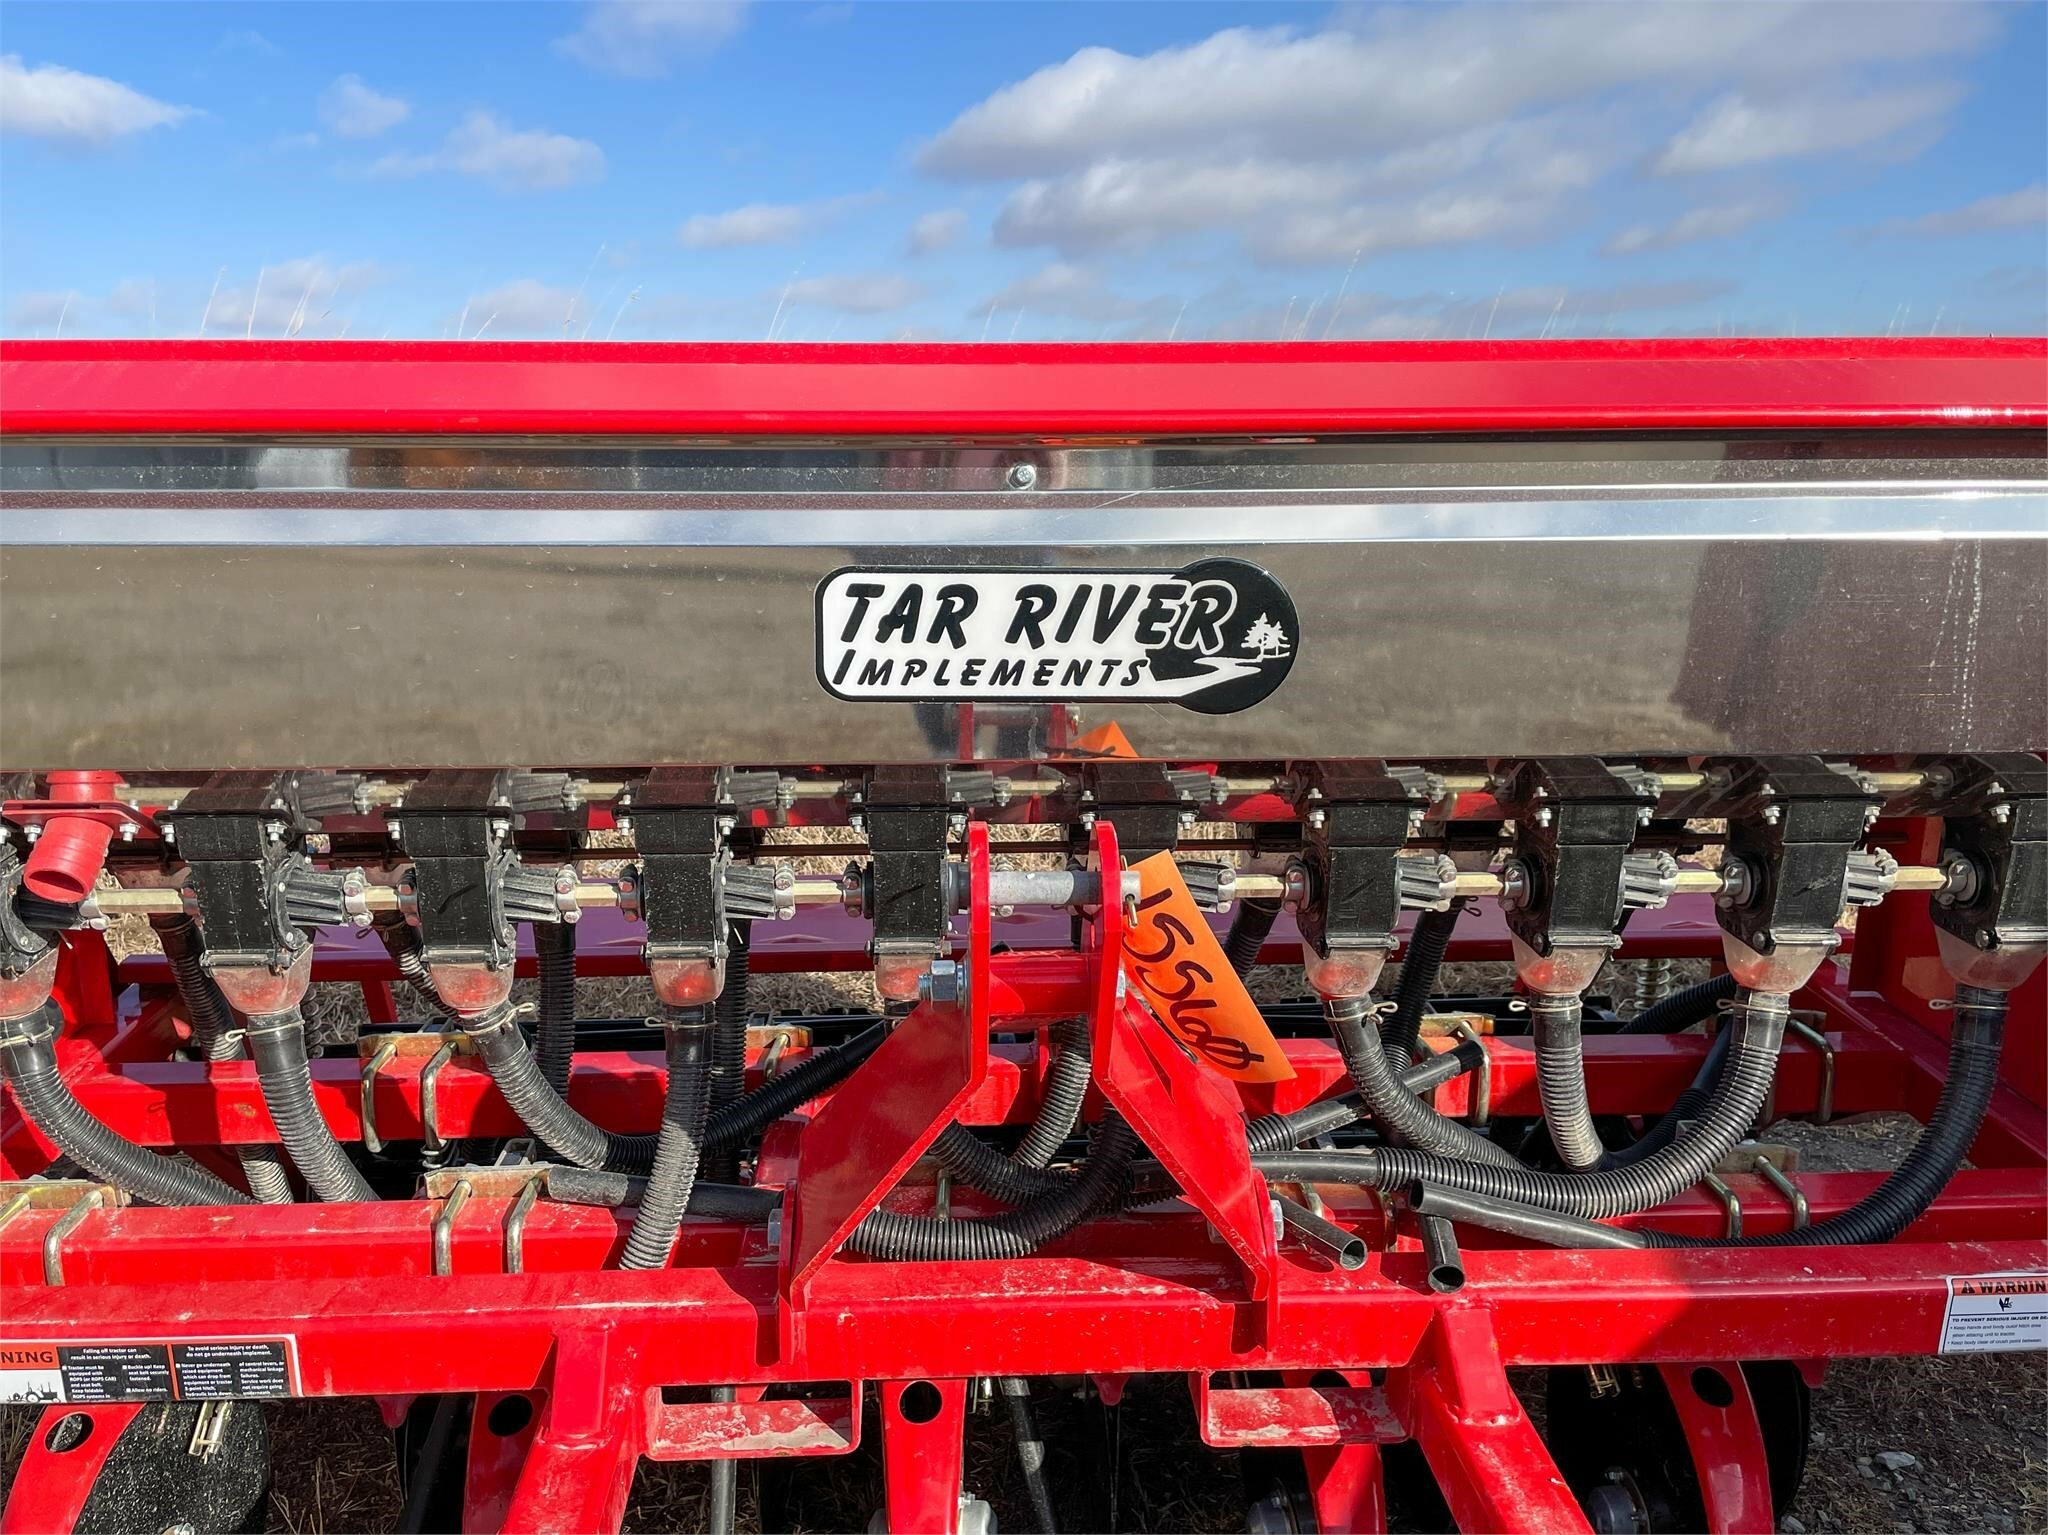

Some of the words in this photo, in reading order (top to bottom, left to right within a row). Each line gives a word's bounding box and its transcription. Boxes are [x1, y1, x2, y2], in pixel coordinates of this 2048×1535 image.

[840, 583, 979, 650] TAR
[1004, 580, 1238, 655] RIVER
[832, 649, 1149, 686] IMPLEMENTS
[0, 1351, 53, 1363] NING
